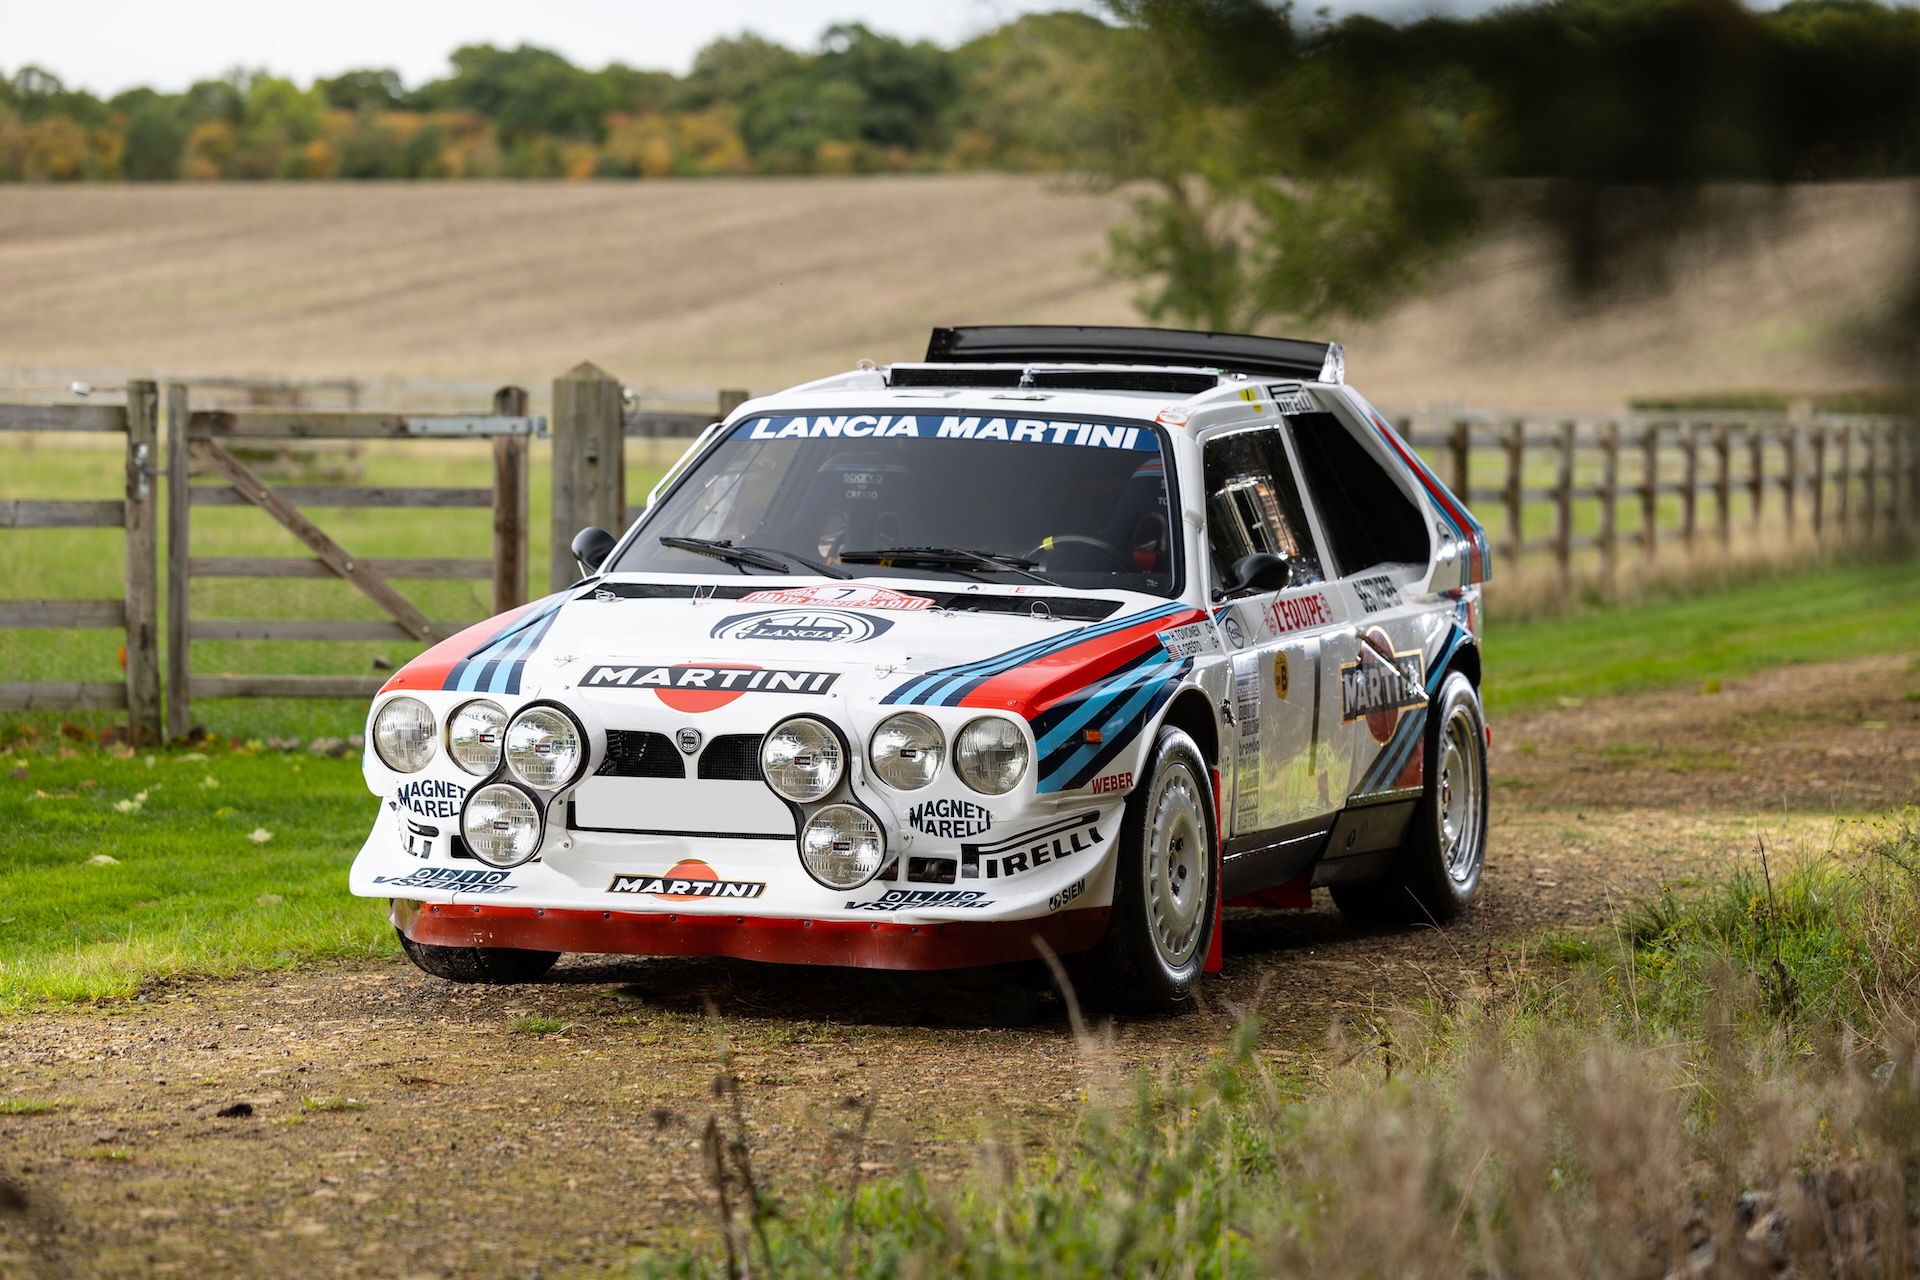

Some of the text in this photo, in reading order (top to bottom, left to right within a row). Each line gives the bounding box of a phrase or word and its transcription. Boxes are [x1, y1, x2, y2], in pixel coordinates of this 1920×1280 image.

[750, 415, 1141, 450] LANCIA MARTINI
[834, 589, 857, 600] 7
[753, 628, 836, 640] LANCIA
[587, 667, 830, 692] MARTINI
[398, 780, 469, 800] MAGNET
[1092, 772, 1133, 794] WEBER
[400, 799, 462, 818] MAREL
[909, 799, 990, 820] MAGNETI
[909, 820, 990, 838] MARELLI
[961, 810, 1104, 879] PIRELLI
[415, 868, 504, 884] OLIO
[613, 878, 760, 898] MARTINI
[882, 890, 980, 902] OLIO
[1062, 878, 1086, 905] SIEM
